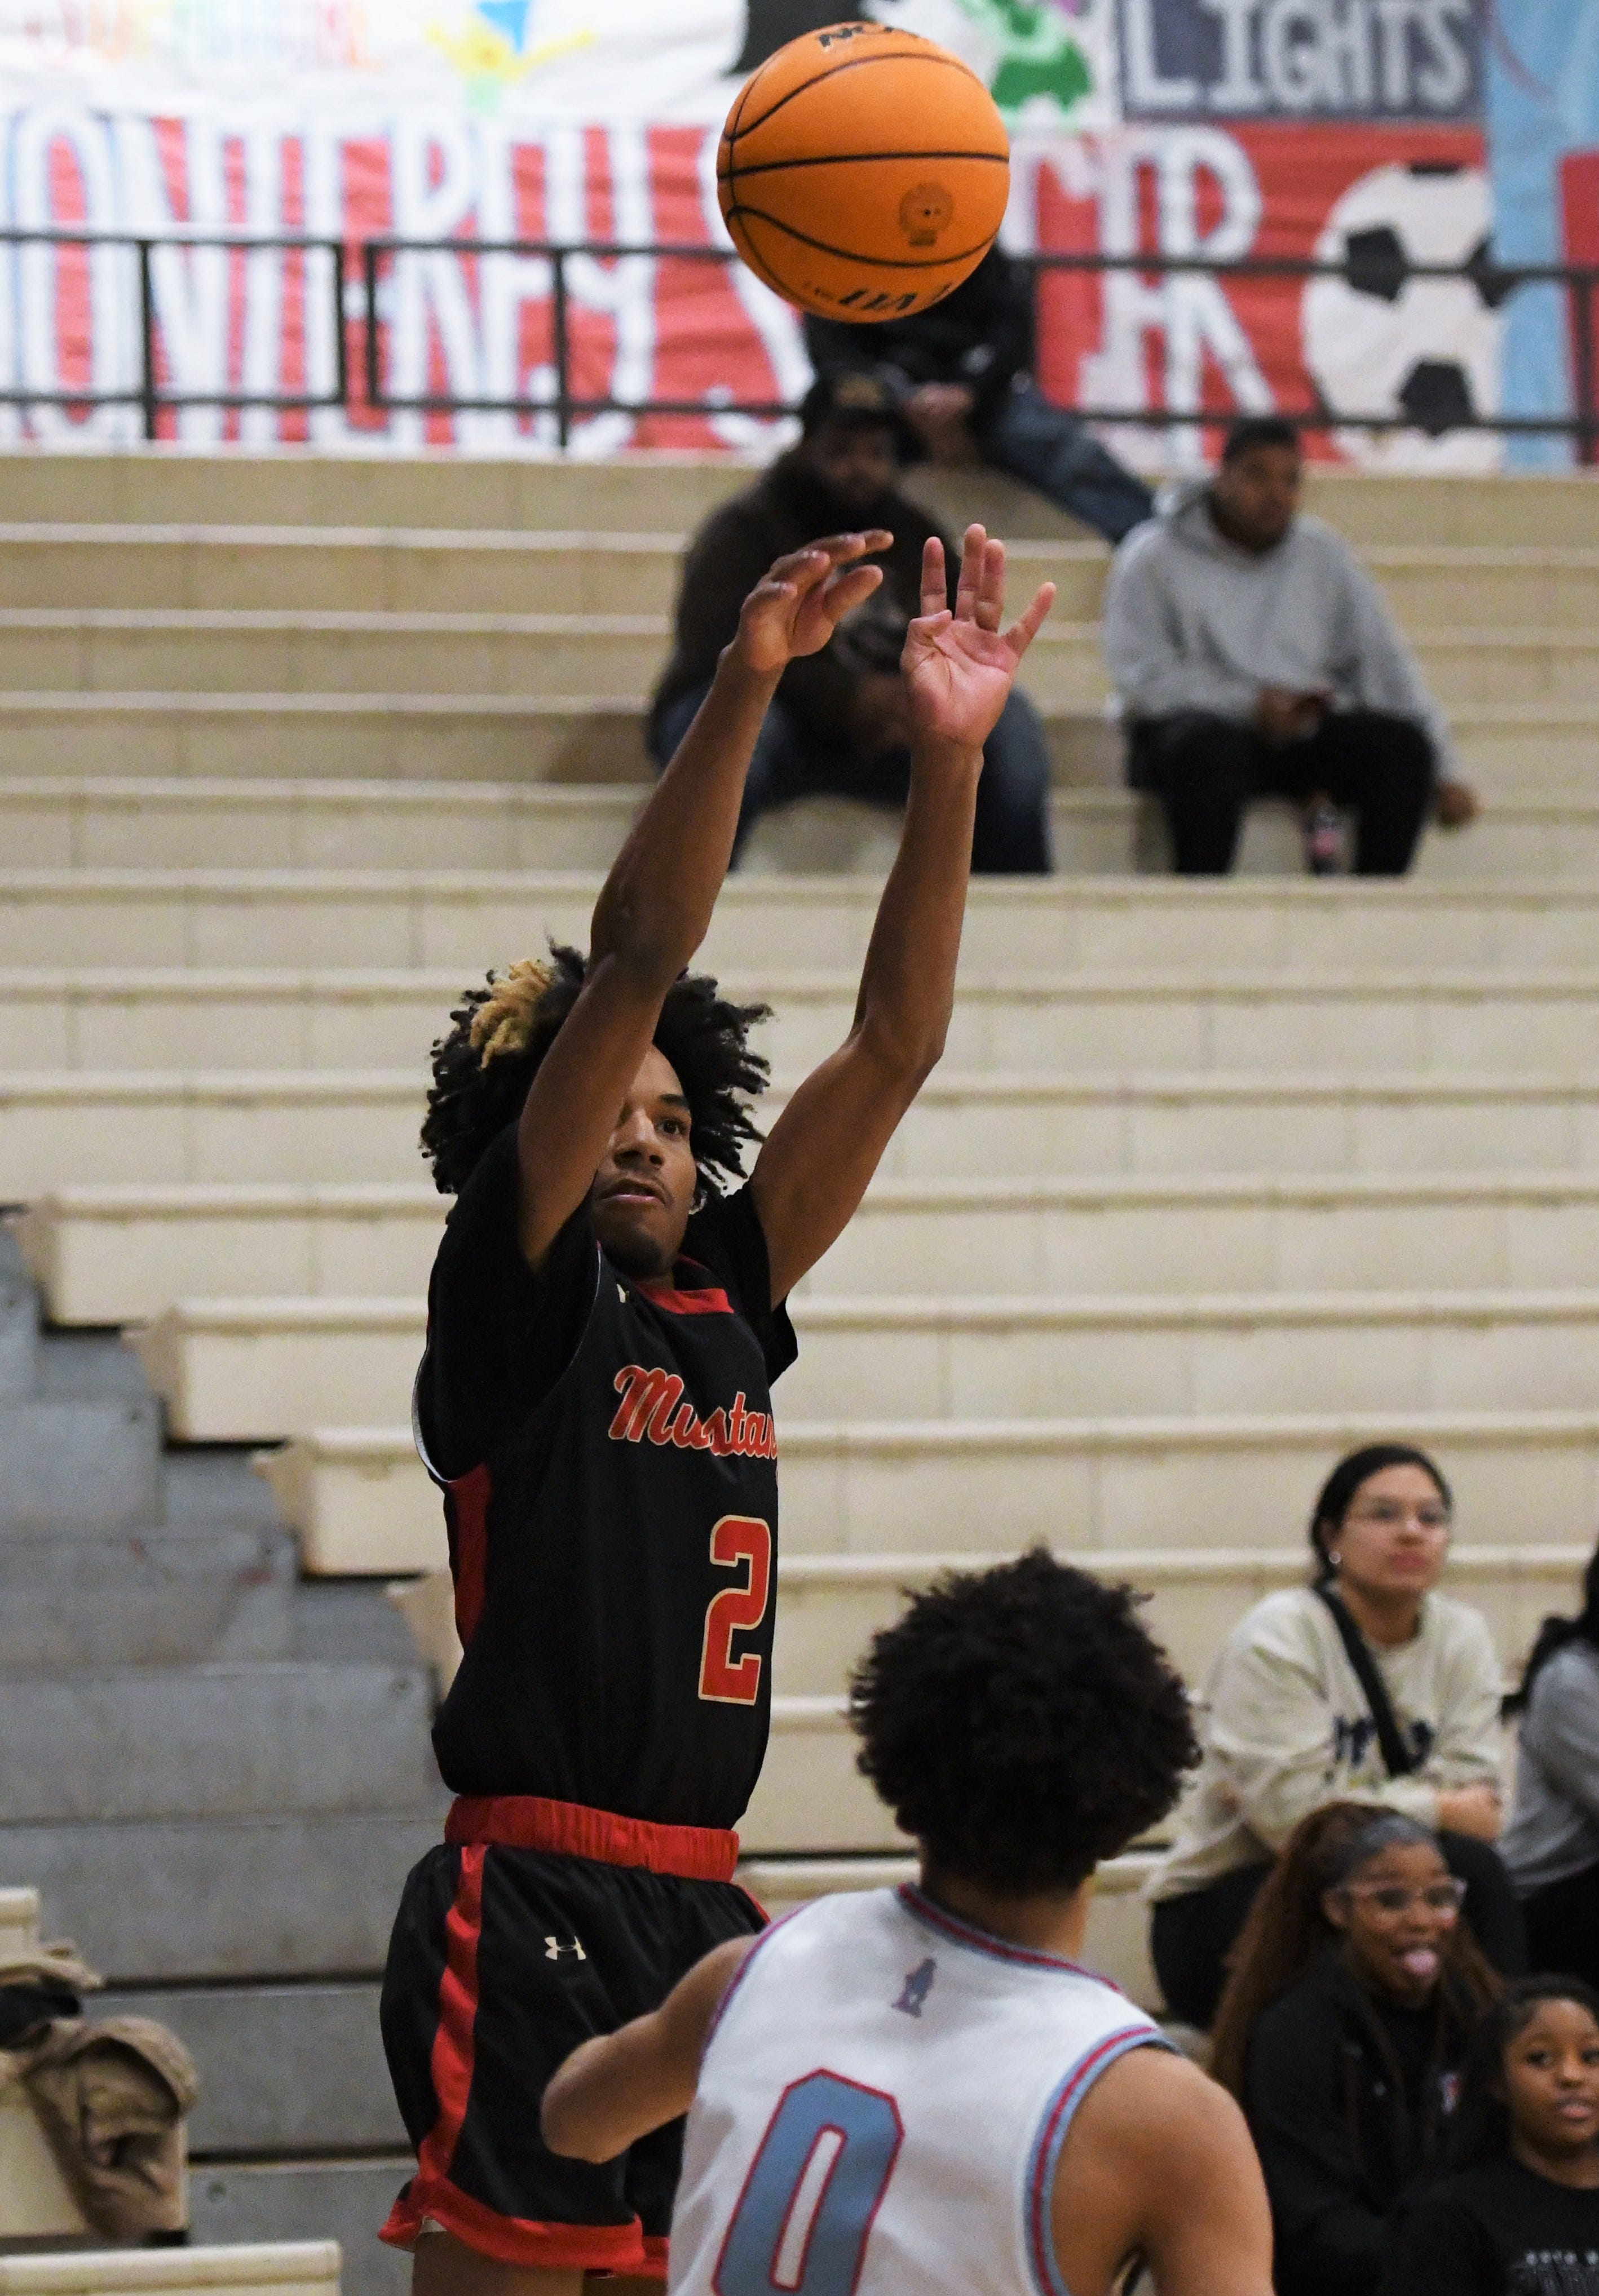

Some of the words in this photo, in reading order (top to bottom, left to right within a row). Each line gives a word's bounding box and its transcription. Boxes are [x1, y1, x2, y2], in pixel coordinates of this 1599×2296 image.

[1127, 0, 1469, 107] LIGHTS
[0, 107, 655, 452] ONTEREY
[608, 1364, 778, 1460] Mustan
[697, 1514, 772, 1706] 2
[710, 2067, 906, 2296] 0
